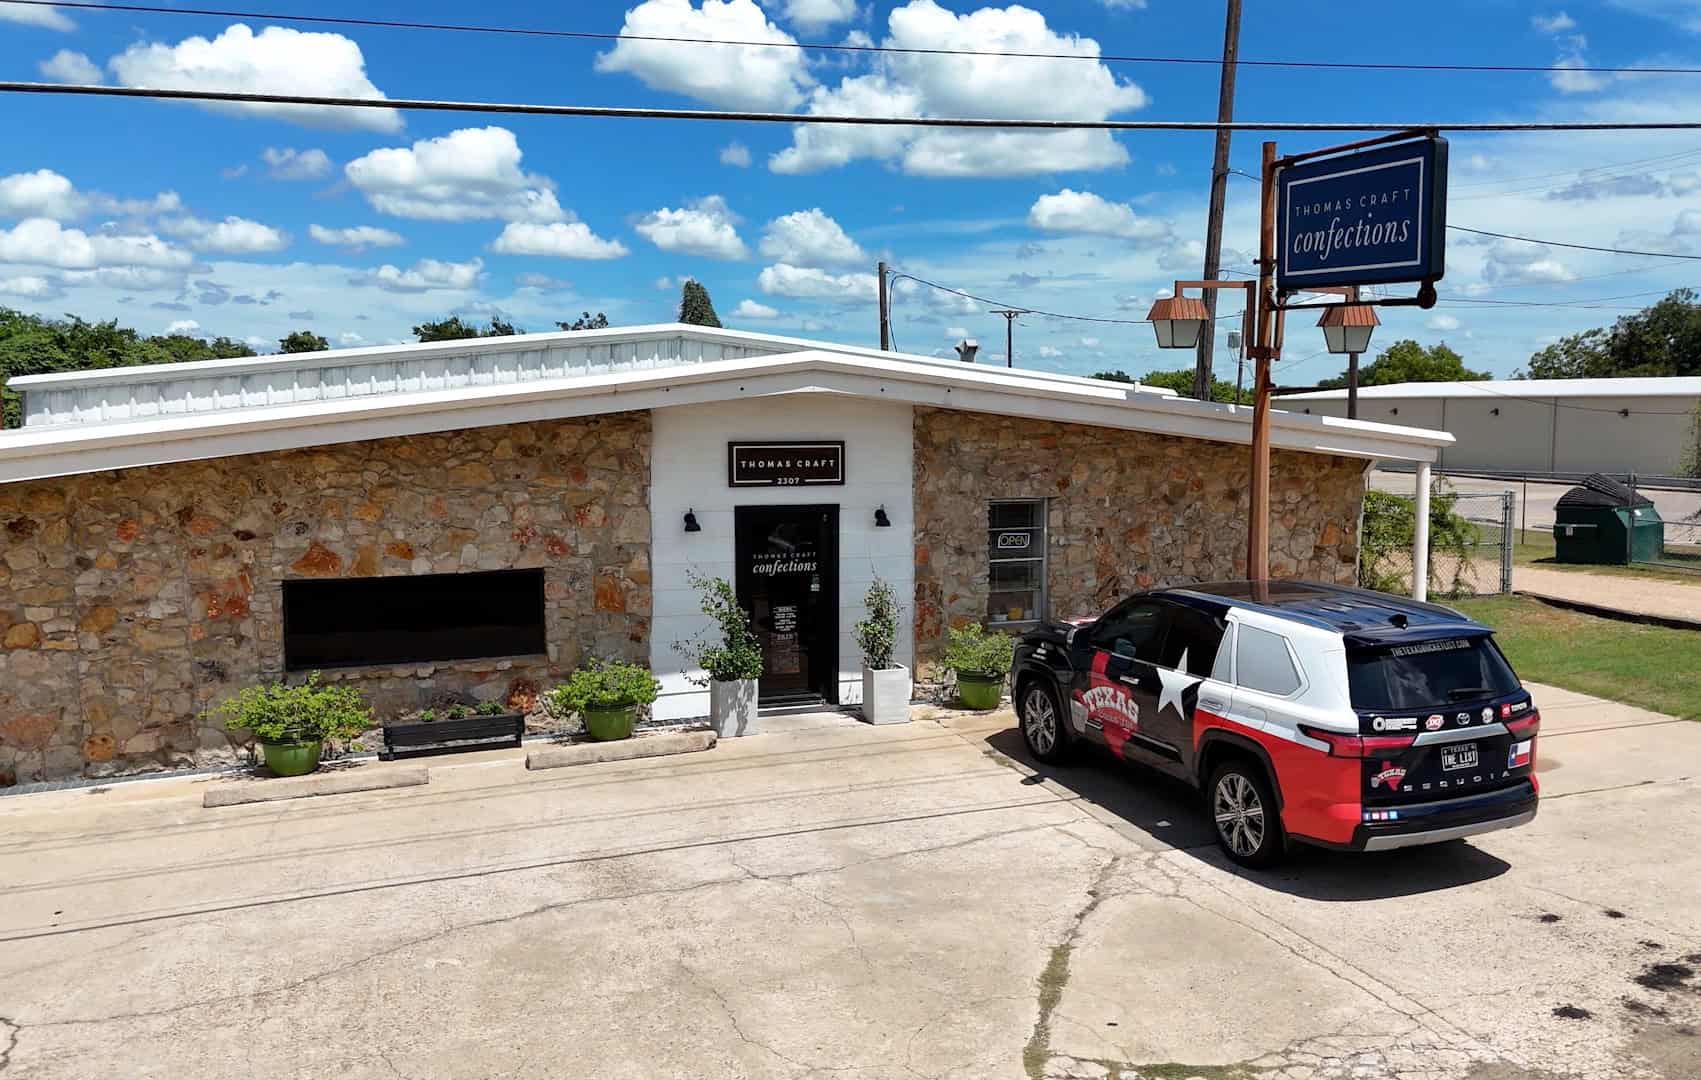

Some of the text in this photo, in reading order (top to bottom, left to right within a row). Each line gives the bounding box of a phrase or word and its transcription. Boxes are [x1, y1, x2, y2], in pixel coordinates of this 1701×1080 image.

[1295, 188, 1411, 216] THOMAS CRAFT
[1293, 212, 1411, 260] confections
[740, 459, 835, 469] THOMAS CRAFT
[776, 477, 800, 485] 2307
[1000, 535, 1028, 546] OPEN
[790, 551, 817, 559] CRAFT
[752, 559, 818, 577] confections
[1082, 686, 1139, 725] TEXAS
[1403, 771, 1511, 791] SEQUOIA
